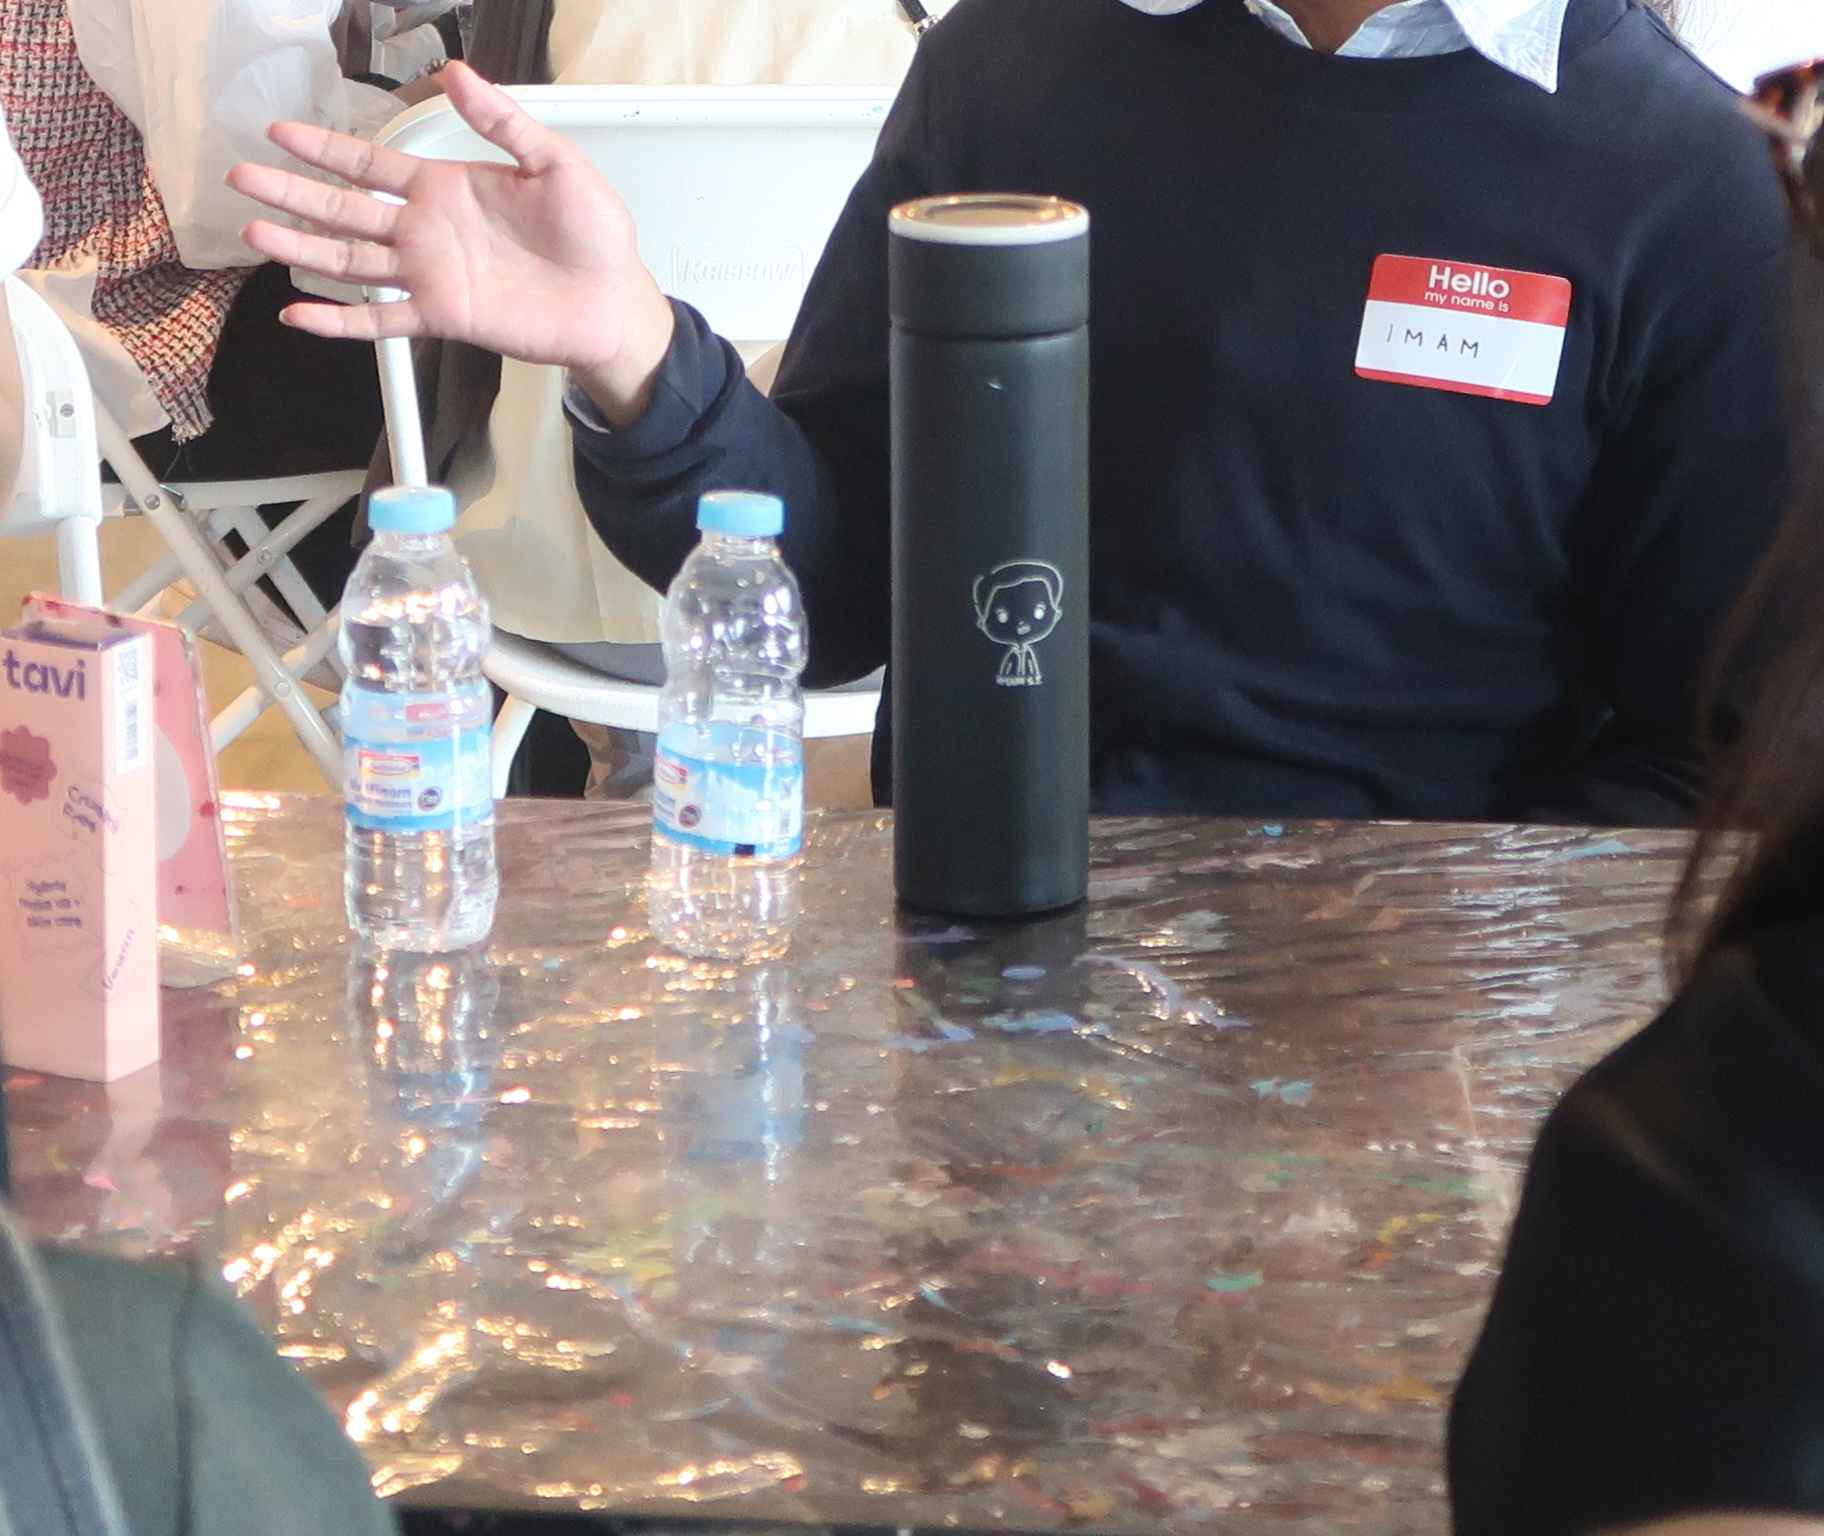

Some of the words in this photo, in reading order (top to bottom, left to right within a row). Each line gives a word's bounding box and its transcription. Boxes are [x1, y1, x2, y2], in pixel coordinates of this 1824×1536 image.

[1428, 265, 1510, 299] Hello
[1424, 291, 1446, 305] my
[1451, 294, 1494, 311] name
[1499, 301, 1510, 313] is
[1387, 324, 1479, 358] IMAM
[3, 649, 86, 701] tavi
